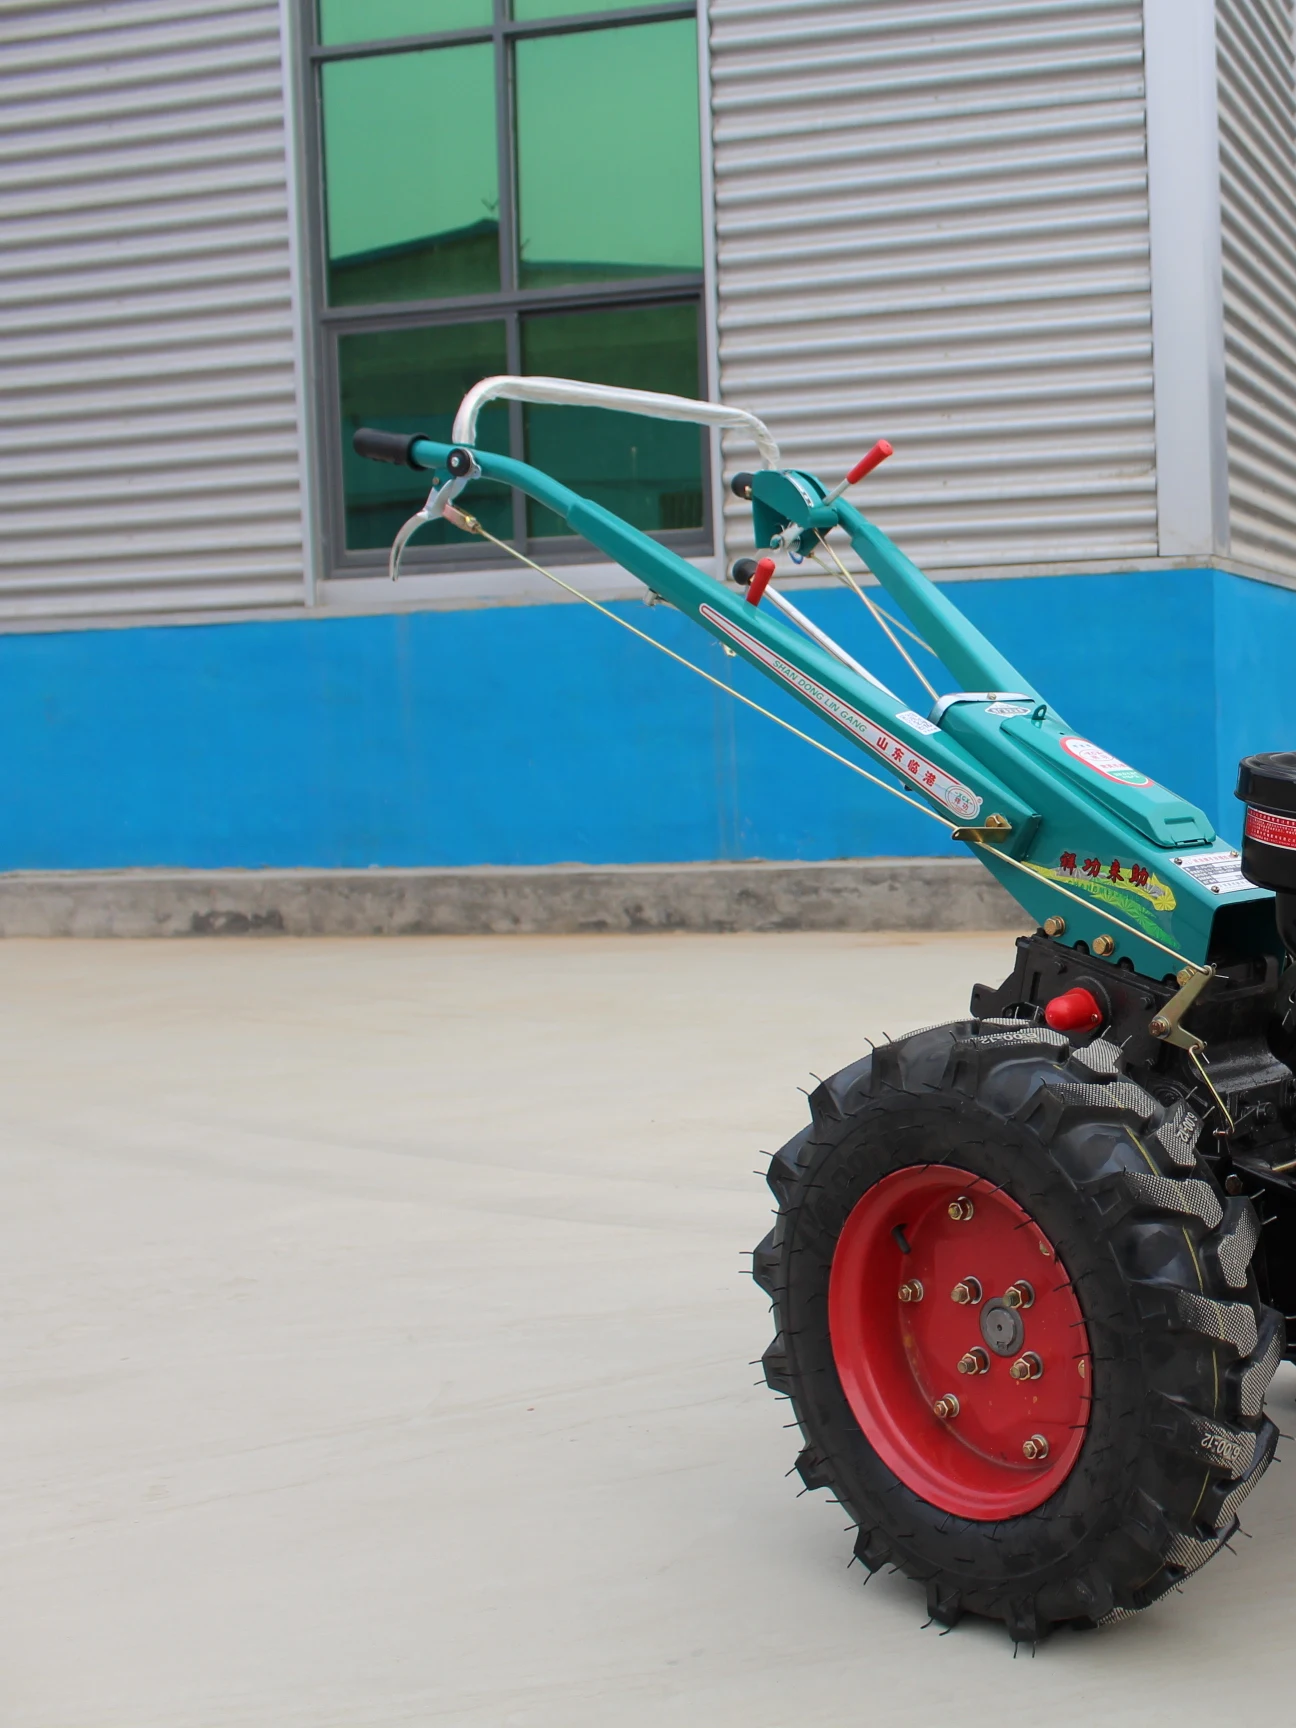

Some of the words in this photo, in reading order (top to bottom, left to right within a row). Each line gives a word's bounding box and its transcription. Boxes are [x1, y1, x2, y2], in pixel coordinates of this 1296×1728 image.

[772, 660, 798, 681] SHAN
[797, 679, 825, 700] DONG
[824, 698, 840, 712] LIN
[840, 710, 867, 733] GANG
[876, 737, 936, 787] 山东临港
